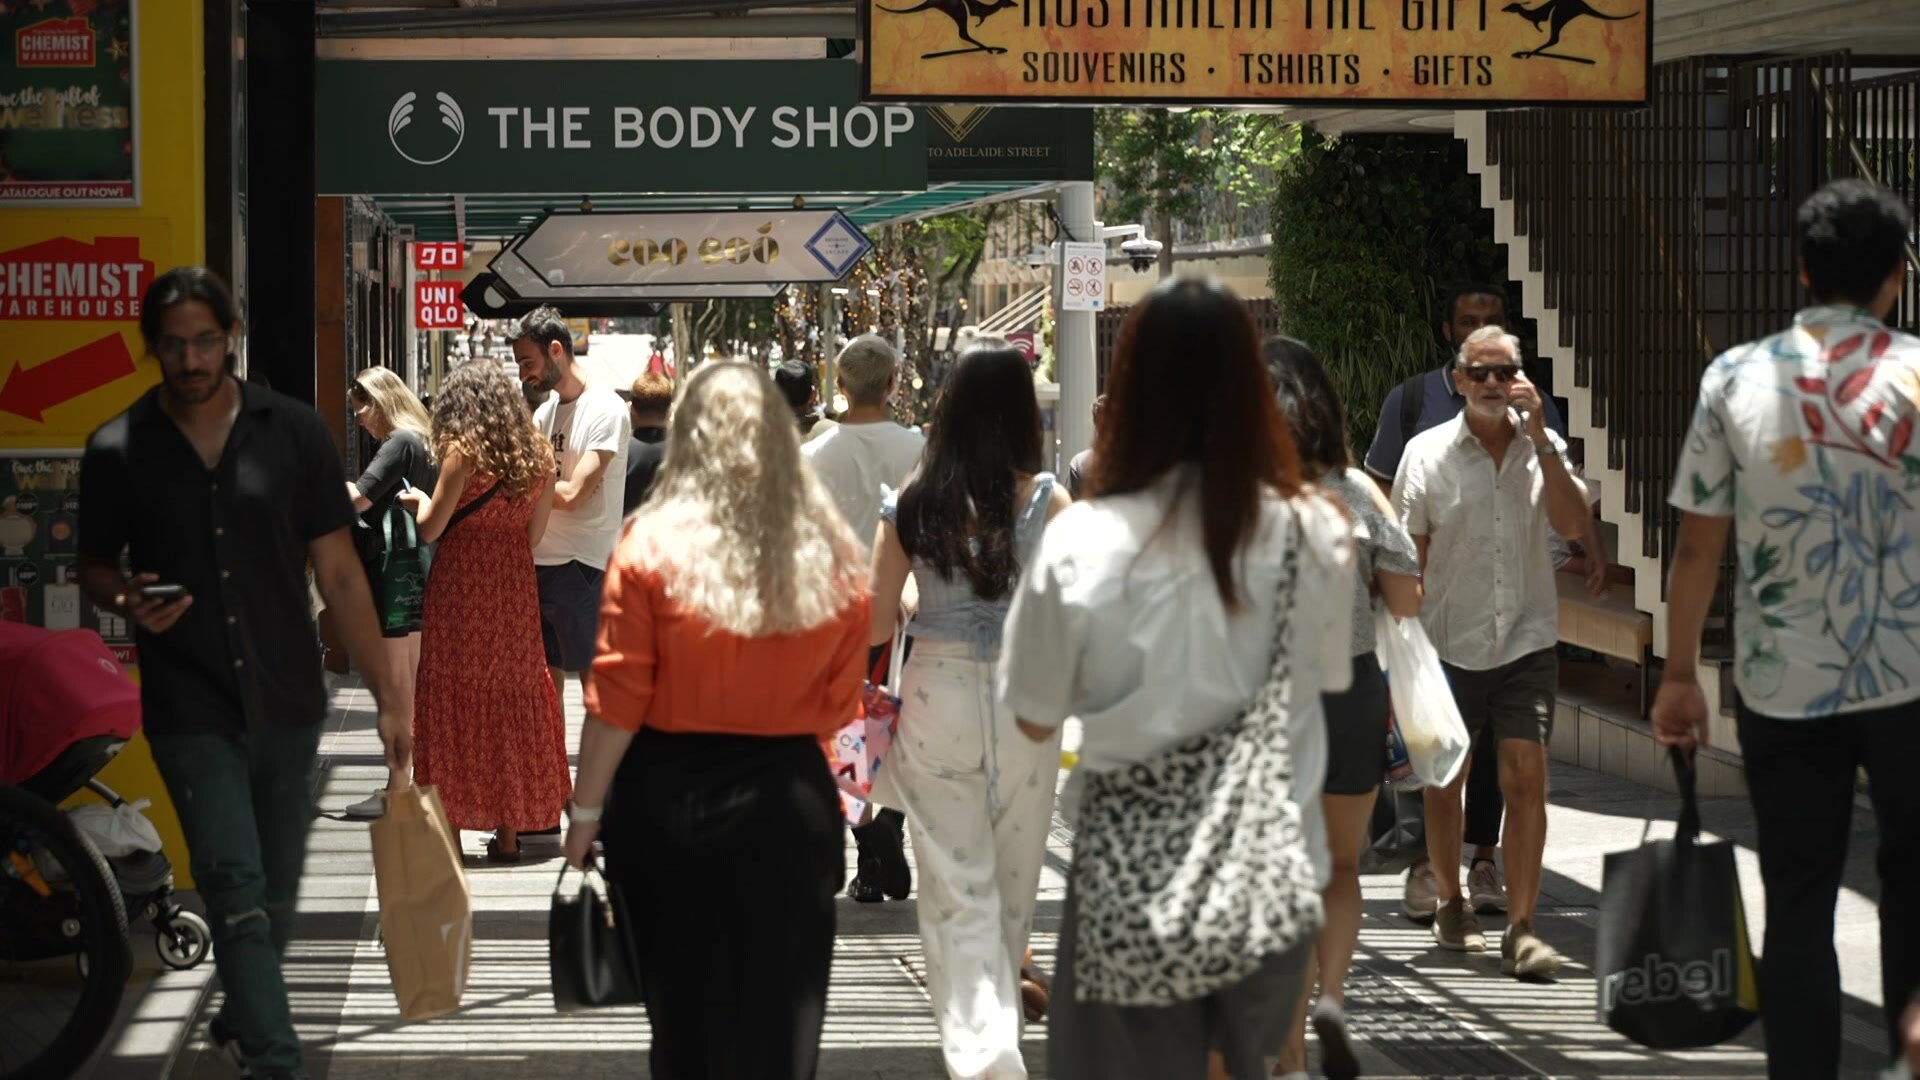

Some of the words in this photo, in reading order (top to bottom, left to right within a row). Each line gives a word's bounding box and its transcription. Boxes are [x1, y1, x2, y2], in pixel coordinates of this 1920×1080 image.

[22, 35, 90, 51] CHEMIST
[1023, 51, 1185, 83] SOUVENIRS
[1239, 53, 1359, 85] TSHIRTS
[1414, 55, 1492, 86] GIFTS
[487, 106, 592, 149] THE
[614, 106, 757, 149] BODY
[770, 105, 915, 149] SHOP
[928, 147, 943, 157] TO
[944, 147, 1005, 157] ADELAIDE
[1007, 147, 1051, 157] STREET
[0, 187, 61, 198] ATALOGUE
[63, 187, 89, 198] OUT
[90, 187, 124, 198] NOW!
[0, 261, 144, 298] HEMIST
[420, 287, 455, 304] UNI
[0, 299, 140, 317] AREHOUSE
[421, 306, 458, 326] QLO
[1602, 948, 1731, 1012] rebel
